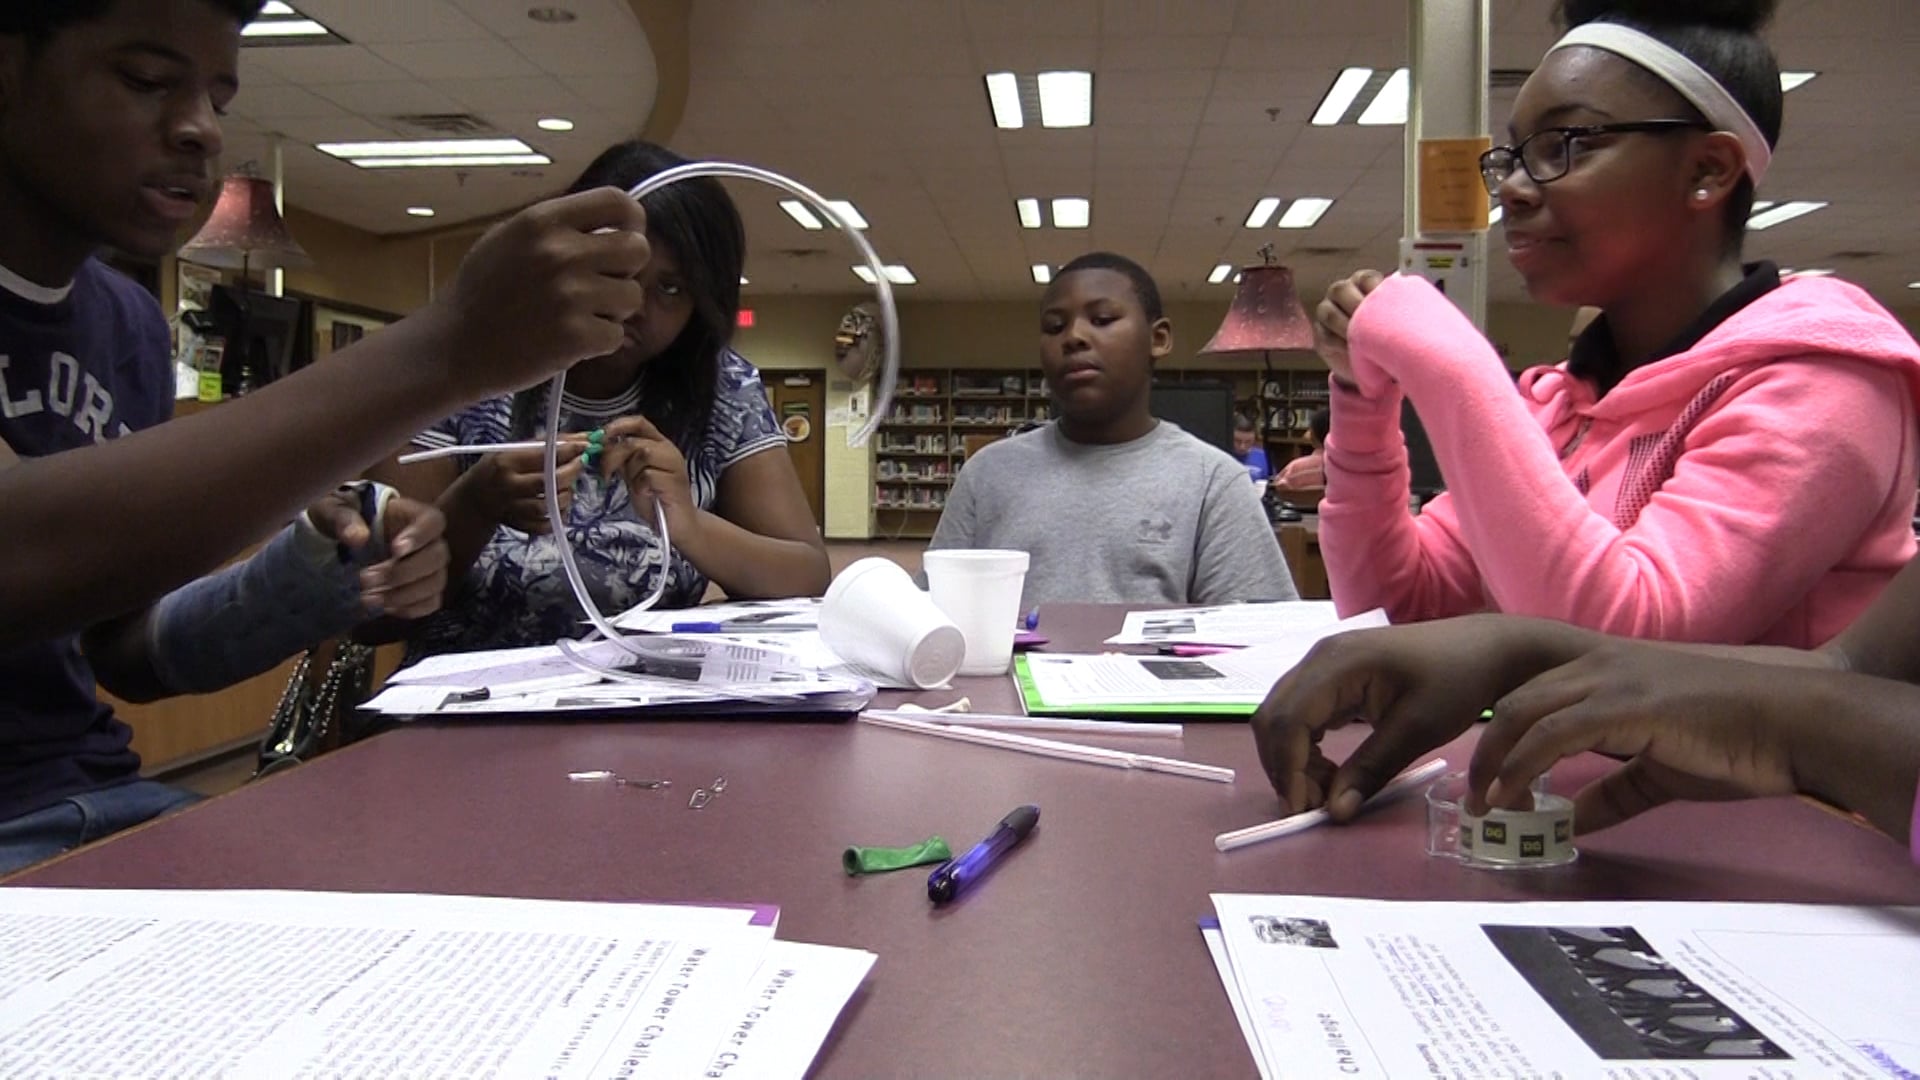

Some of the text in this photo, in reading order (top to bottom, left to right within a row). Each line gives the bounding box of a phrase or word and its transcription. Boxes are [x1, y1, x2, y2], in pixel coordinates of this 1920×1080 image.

[679, 947, 711, 978] Water
[652, 982, 689, 1020] Tower
[761, 968, 796, 999] Water
[730, 1005, 770, 1045] Tower
[1317, 1012, 1359, 1074] Challenge
